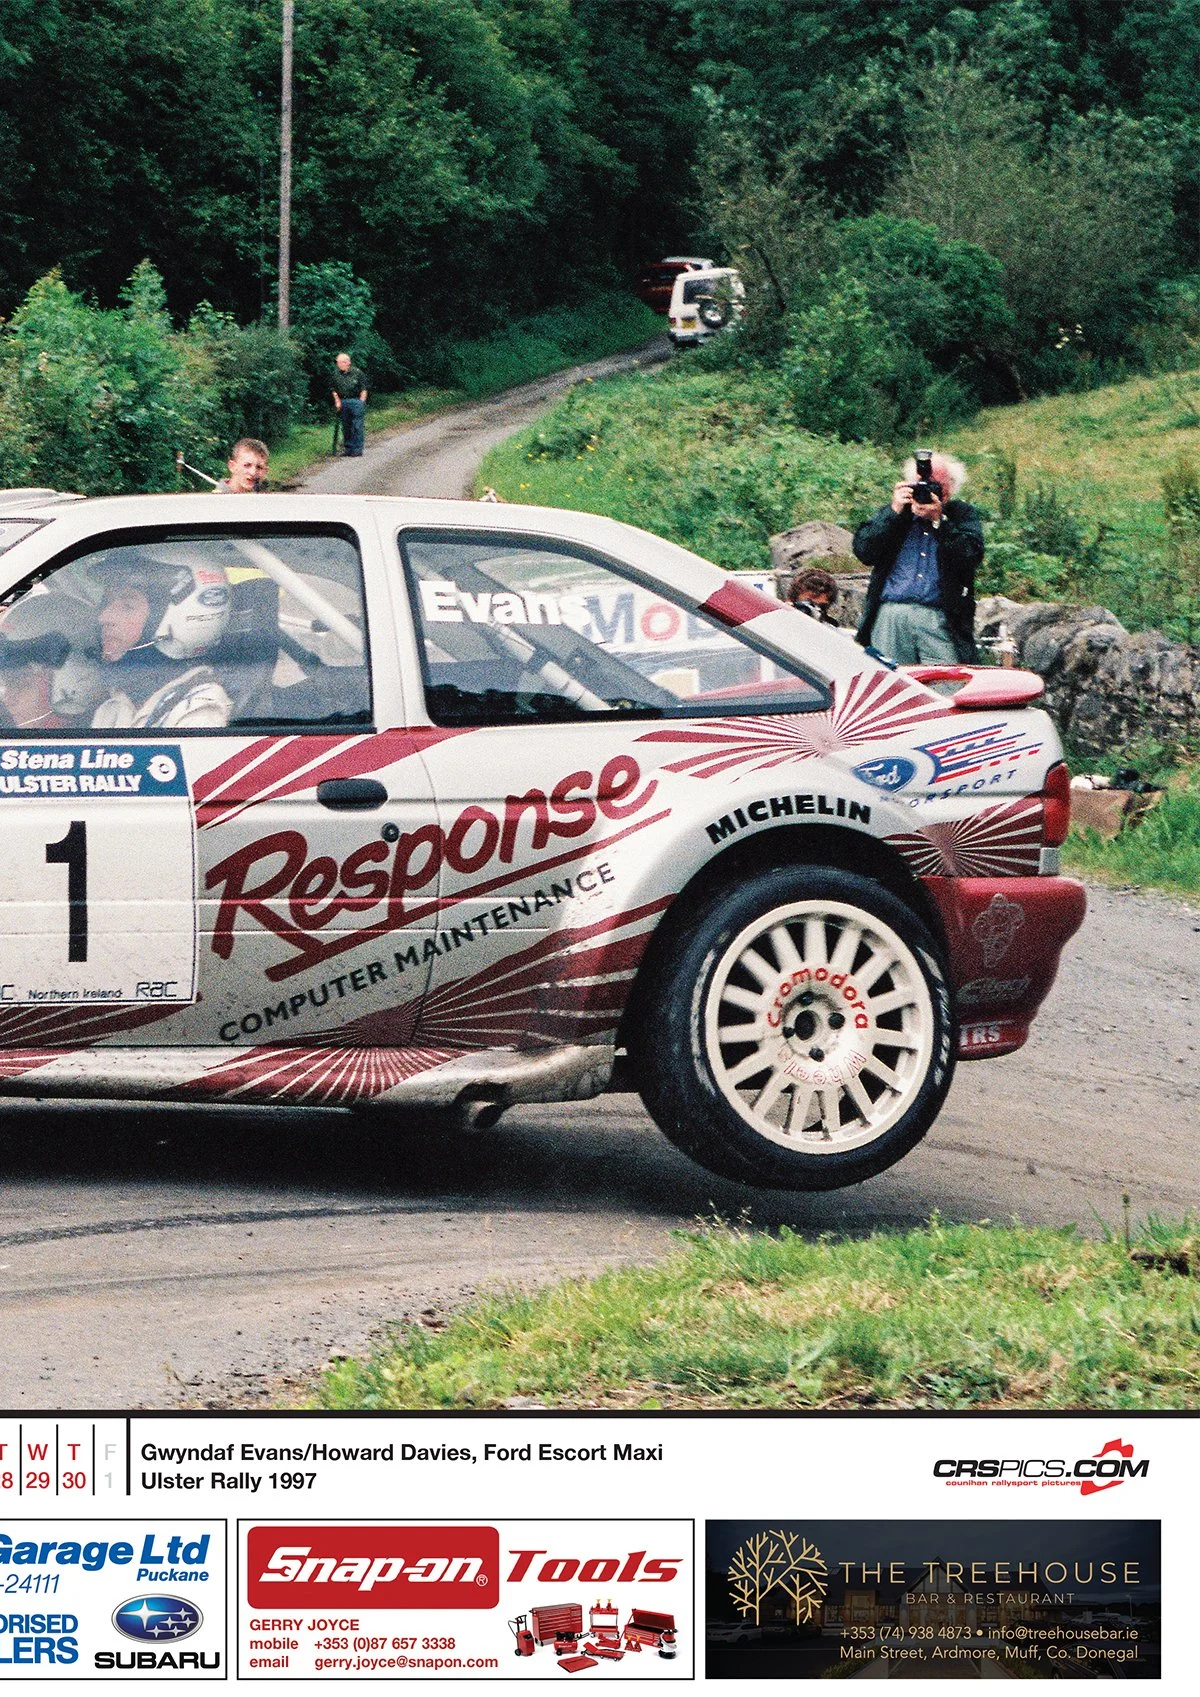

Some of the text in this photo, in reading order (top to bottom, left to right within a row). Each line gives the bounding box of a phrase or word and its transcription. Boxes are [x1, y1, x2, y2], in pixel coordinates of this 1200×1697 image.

[419, 580, 594, 625] Evans
[0, 749, 134, 769] Stena Line
[79, 775, 142, 792] RALLY
[705, 795, 871, 844] MICHELIN
[46, 820, 88, 962] 1
[205, 755, 668, 980] Response
[218, 862, 616, 1042] COMPUTER MAINTENANCE
[28, 988, 79, 1000] Northern
[83, 987, 123, 999] Ireland
[767, 967, 869, 1029] Cromodora
